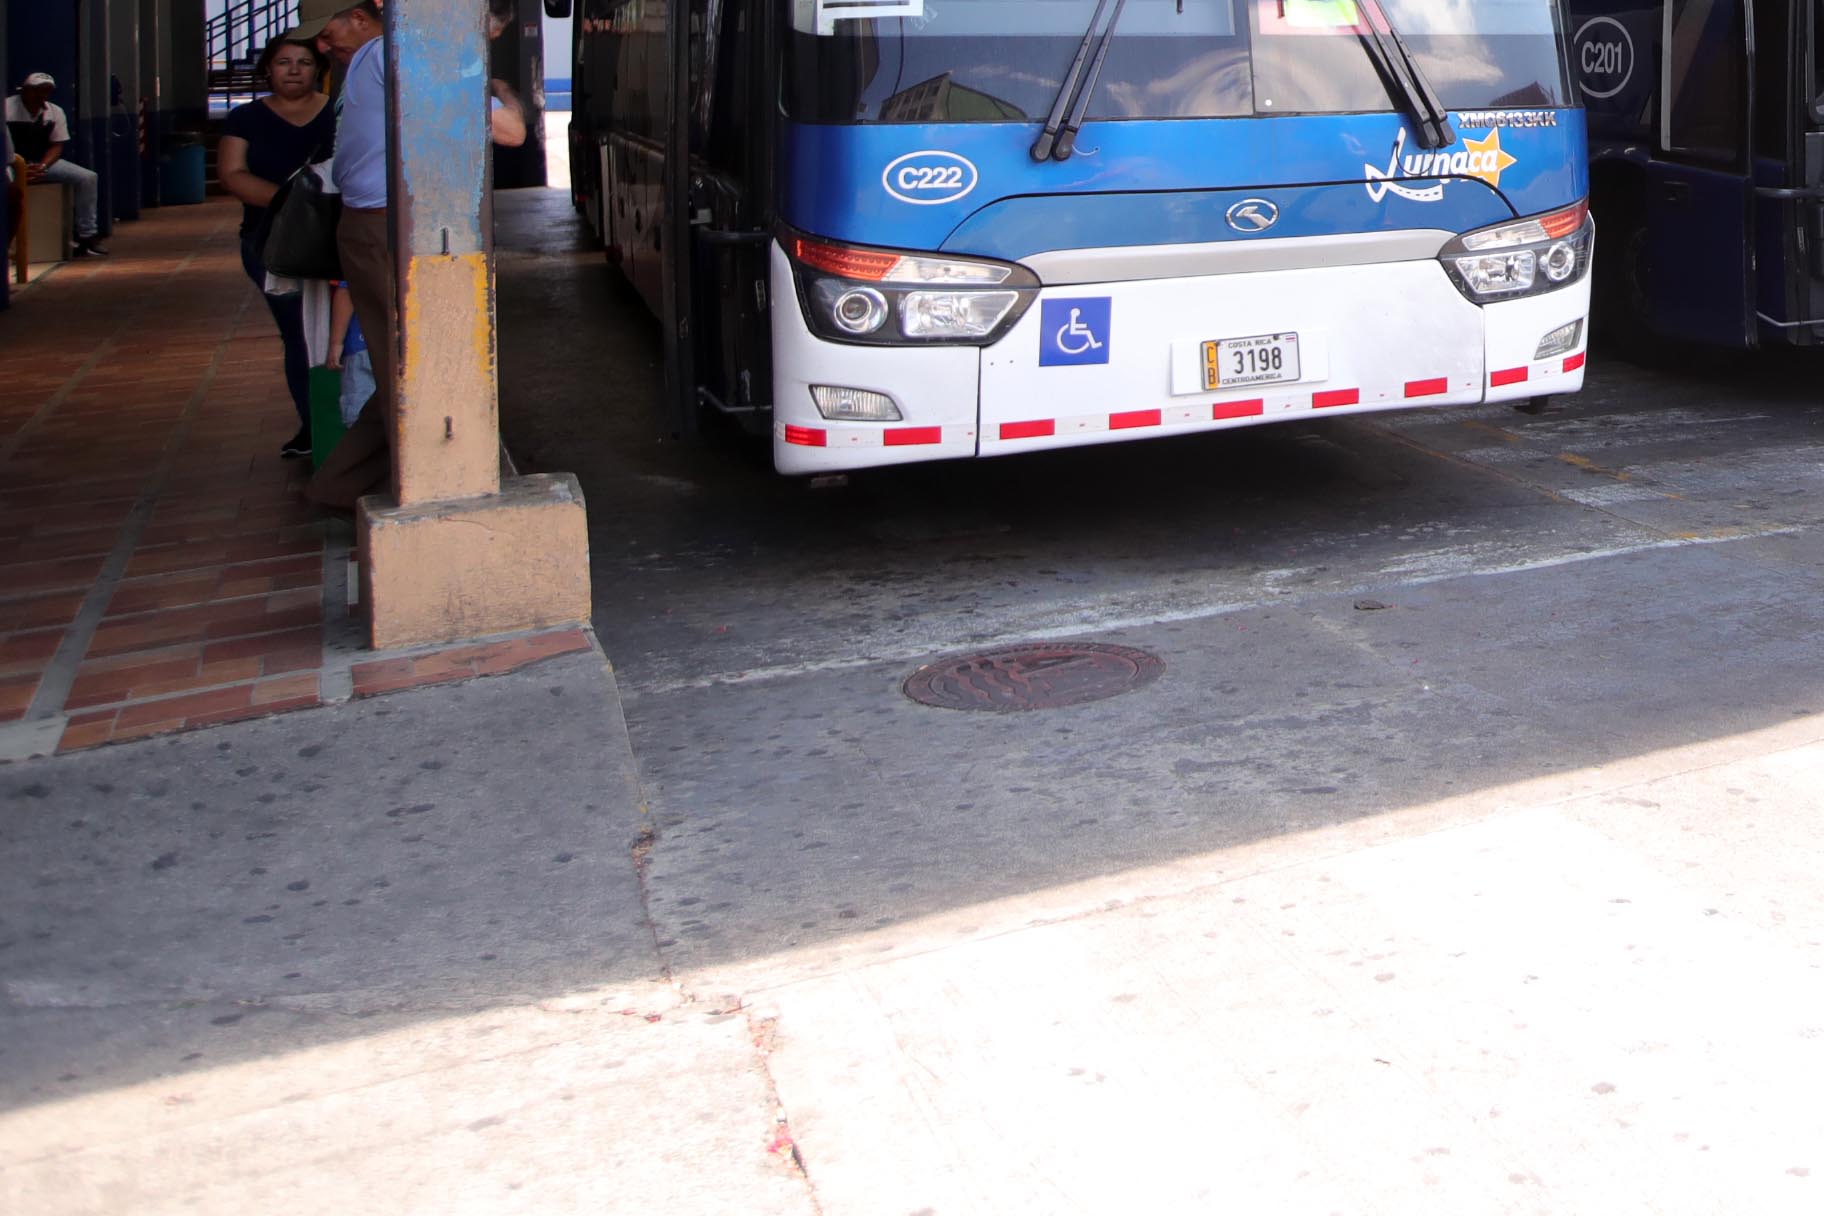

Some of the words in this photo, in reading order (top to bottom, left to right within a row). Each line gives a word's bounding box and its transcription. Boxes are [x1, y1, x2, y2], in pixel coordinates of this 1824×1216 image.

[1581, 40, 1623, 74] C201
[1364, 126, 1497, 203] Lumaca
[898, 166, 962, 190] C222
[1228, 341, 1252, 349] COSTA
[1255, 338, 1272, 346] RICA
[1233, 346, 1282, 374] 3198
[1222, 373, 1282, 384] CENTROAMERICA
